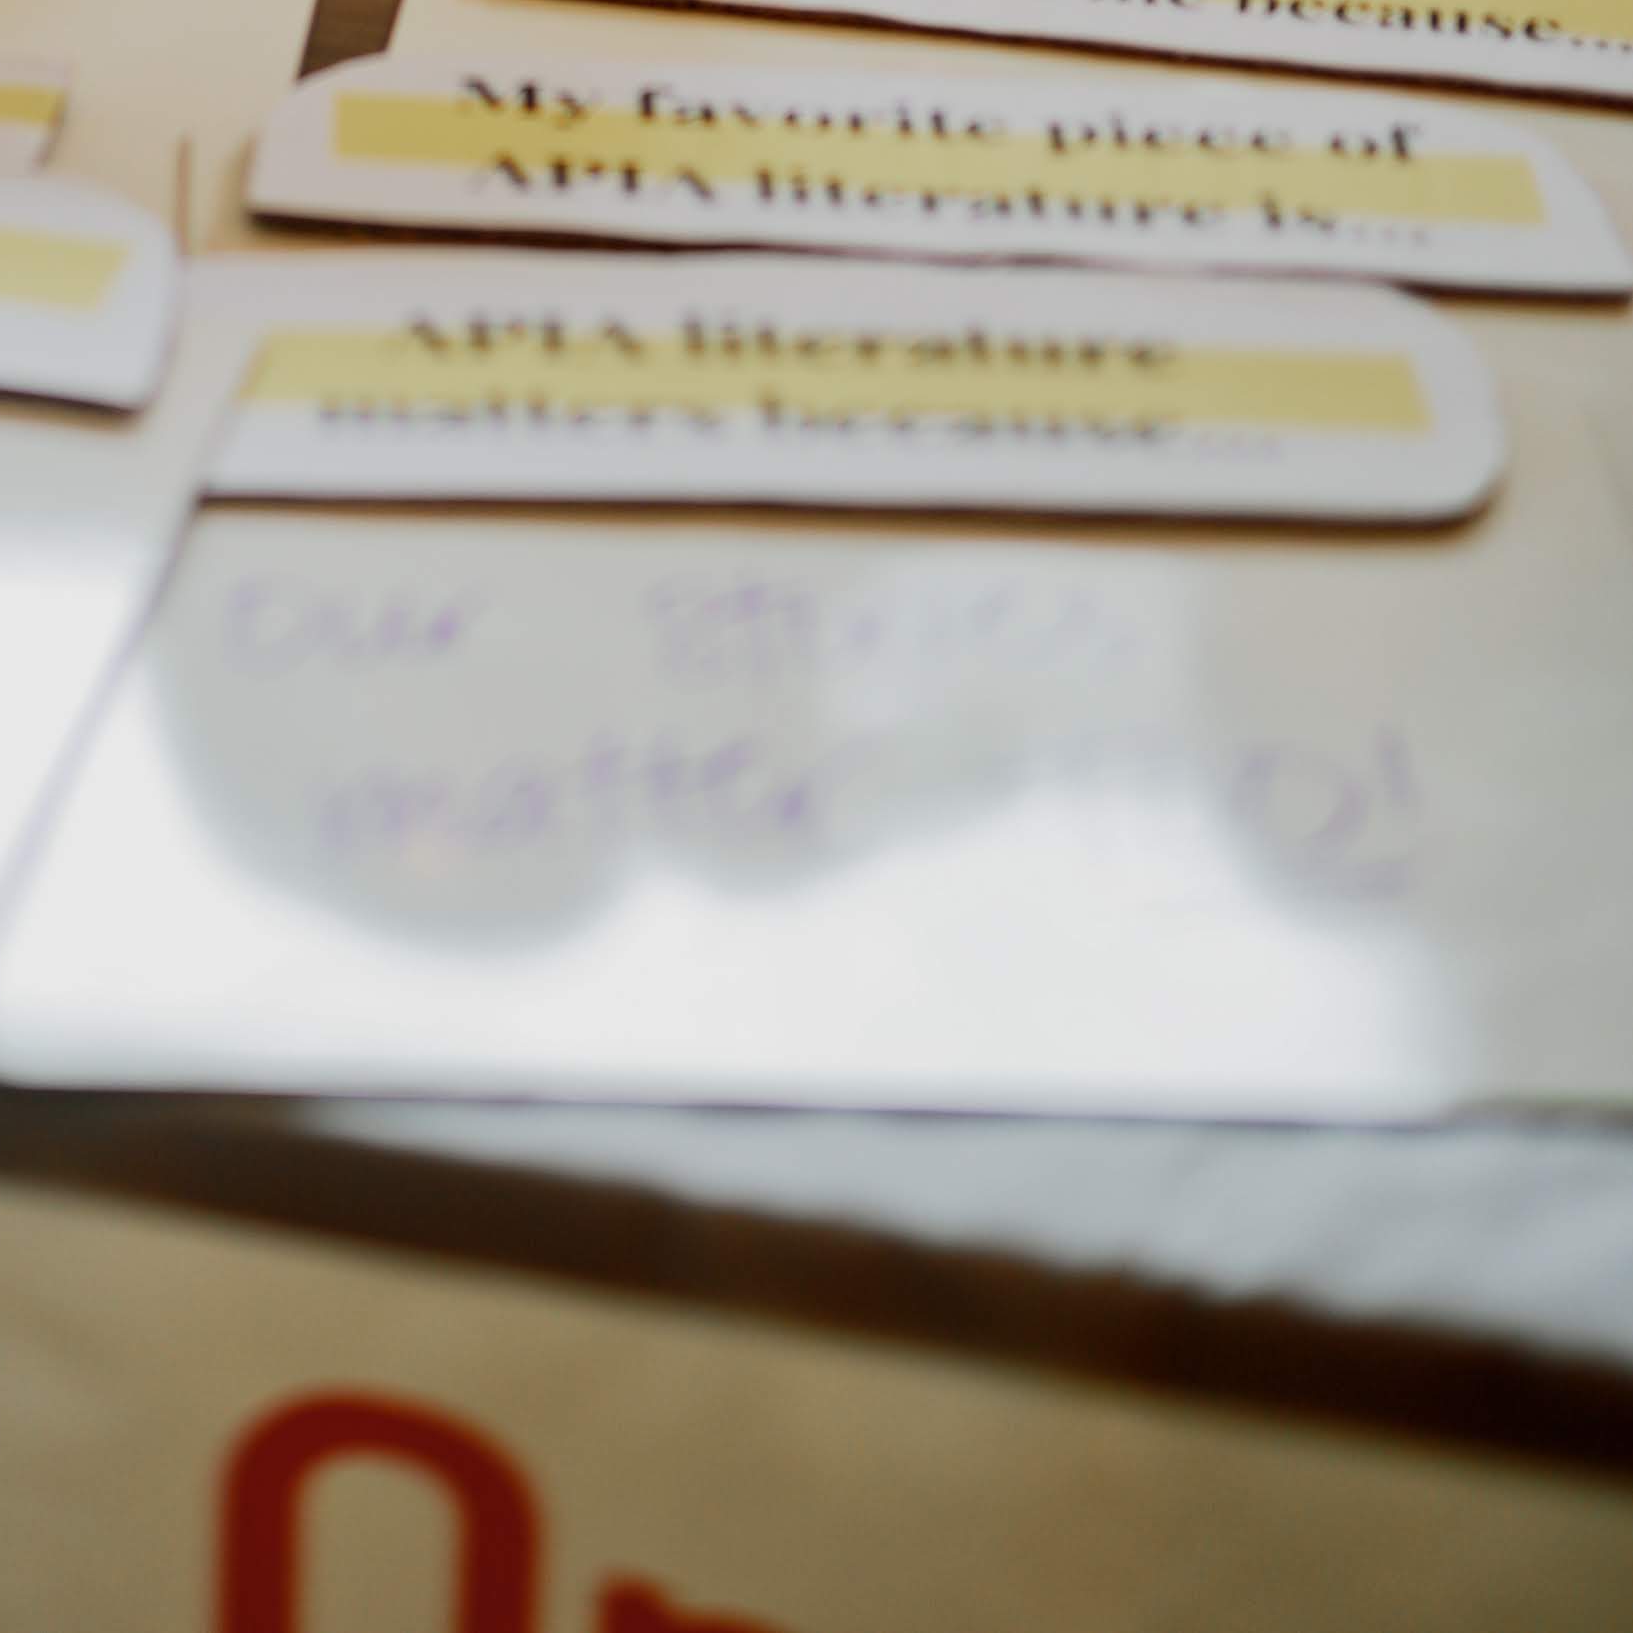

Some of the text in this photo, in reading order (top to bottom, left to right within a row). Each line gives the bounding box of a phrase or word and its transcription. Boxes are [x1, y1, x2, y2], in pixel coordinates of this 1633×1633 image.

[458, 77, 1426, 162] My favorite piece of
[473, 150, 718, 201] APIA
[756, 163, 1230, 225] literature
[388, 309, 1180, 373] APIA literature
